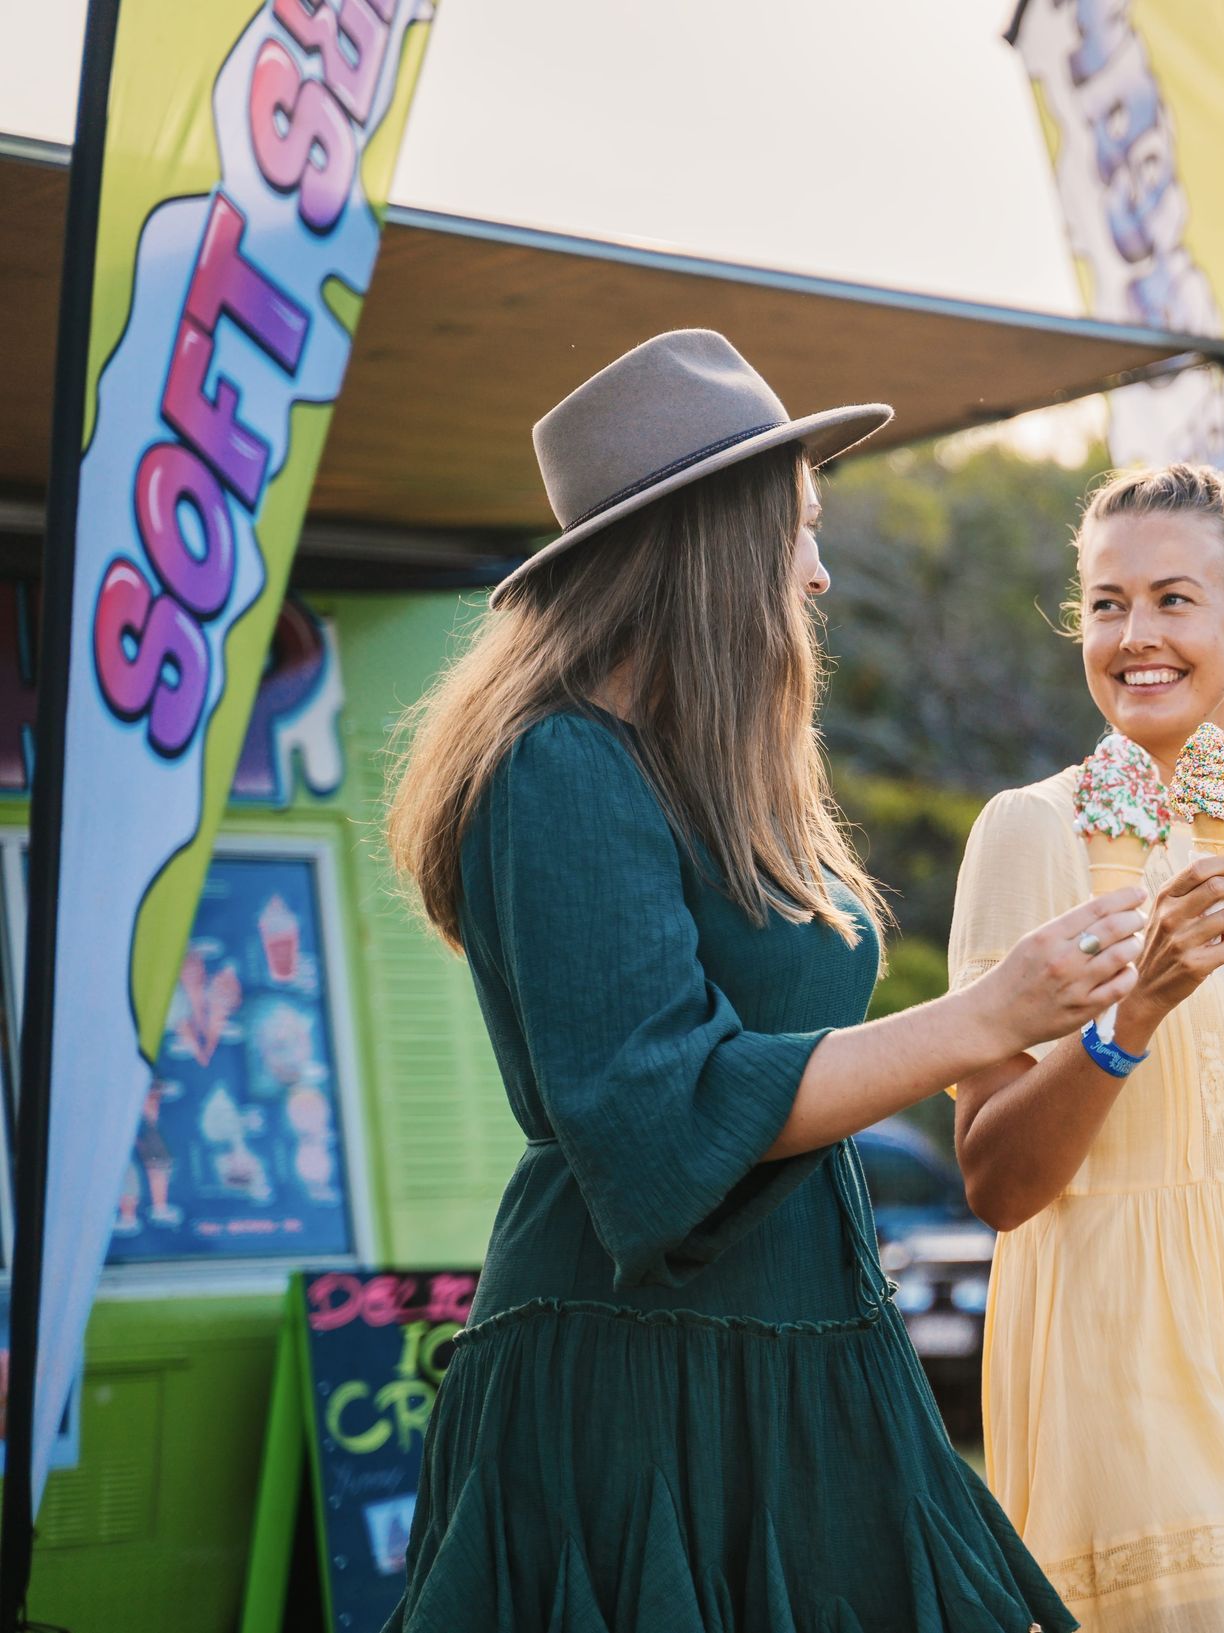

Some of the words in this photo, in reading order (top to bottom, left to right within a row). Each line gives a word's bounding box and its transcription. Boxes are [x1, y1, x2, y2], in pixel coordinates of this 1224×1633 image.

[93, 190, 310, 760] SOFT
[249, 0, 395, 237] SE
[397, 1321, 464, 1383] IC
[327, 1379, 437, 1454] CR
